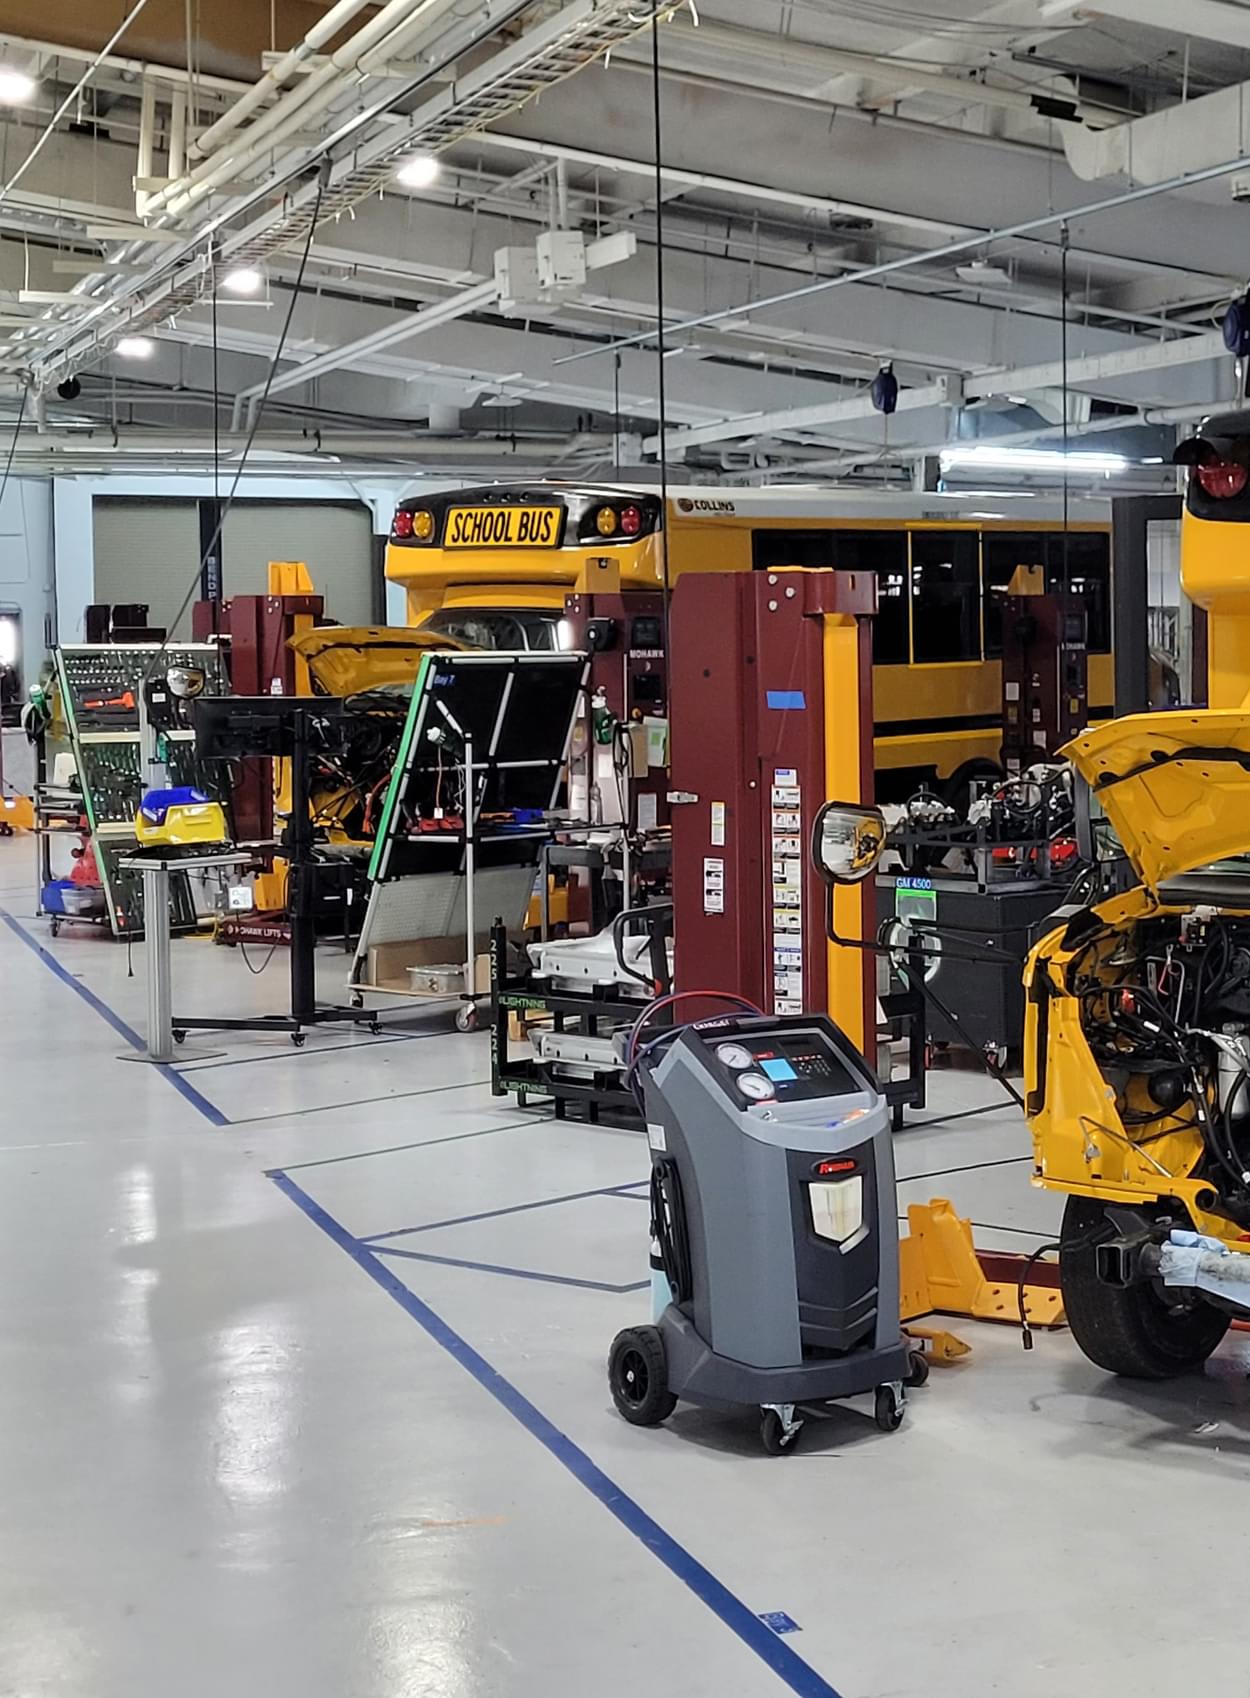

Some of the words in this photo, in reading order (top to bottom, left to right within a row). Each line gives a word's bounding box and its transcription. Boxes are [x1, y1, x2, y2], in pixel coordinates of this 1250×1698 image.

[694, 499, 736, 512] COLLINS
[451, 511, 513, 543] SCHOOL
[517, 511, 553, 542] BUS
